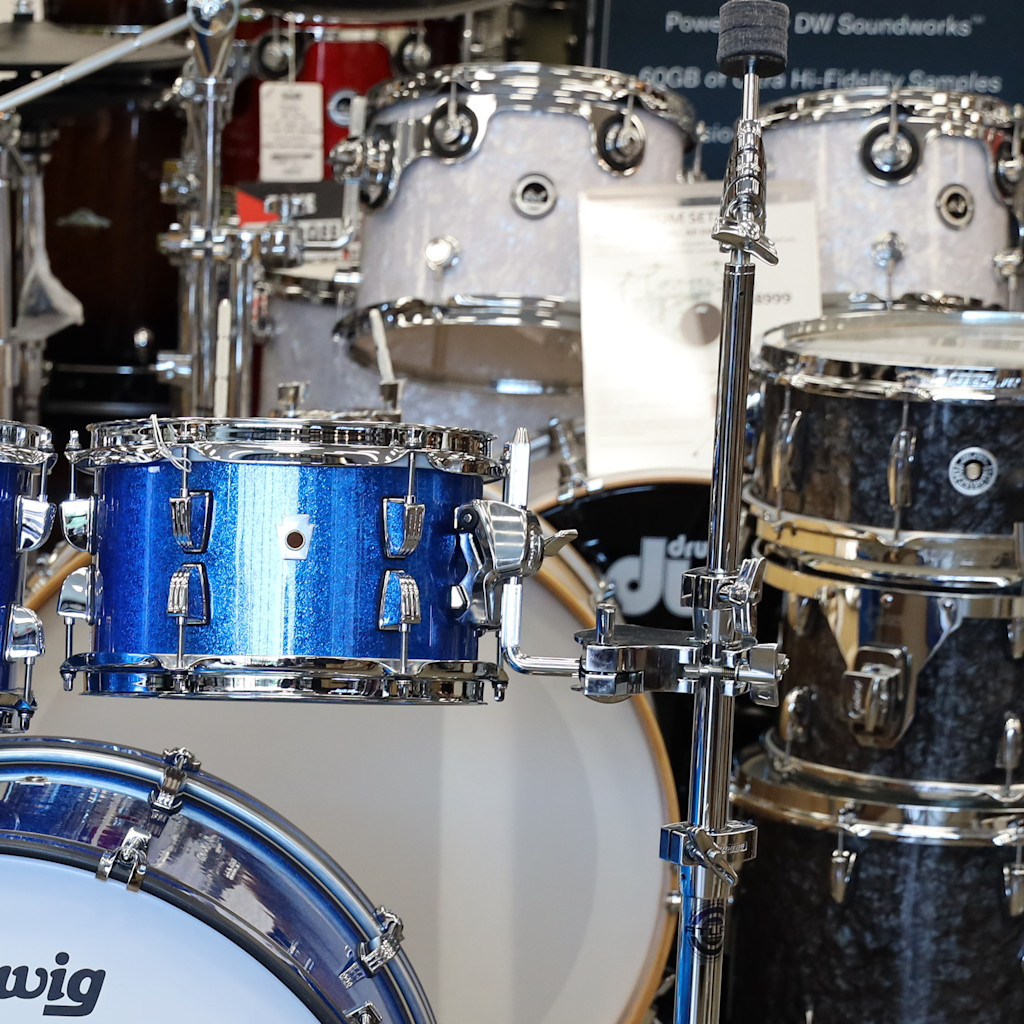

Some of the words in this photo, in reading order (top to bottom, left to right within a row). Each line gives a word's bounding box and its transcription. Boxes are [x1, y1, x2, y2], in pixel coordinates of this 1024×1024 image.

[665, 11, 721, 33] Powe
[794, 12, 835, 35] DW
[907, 69, 1003, 93] Samples
[667, 534, 709, 559] dru
